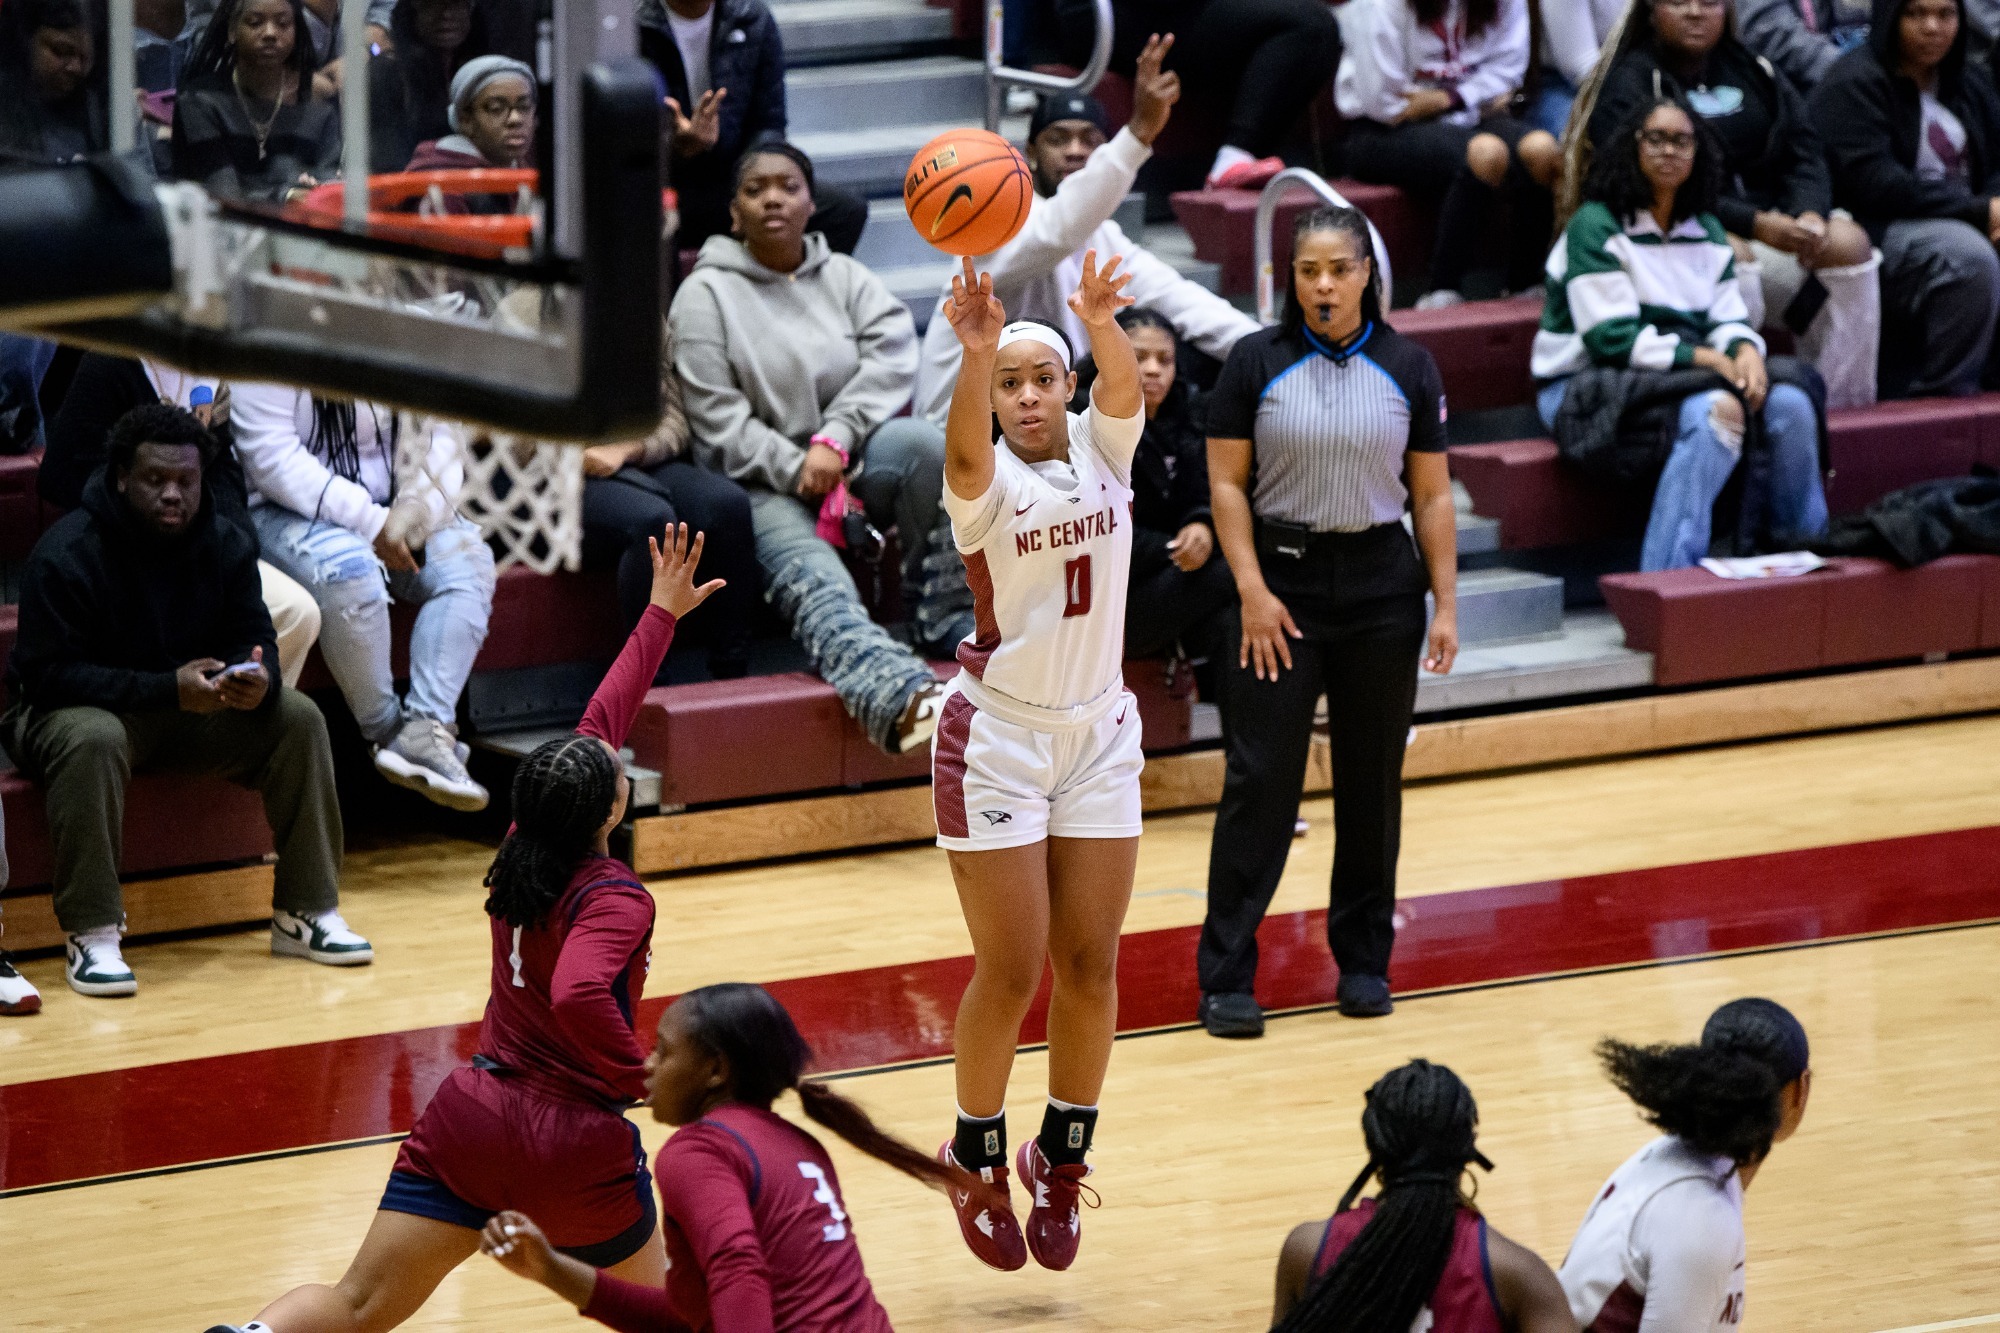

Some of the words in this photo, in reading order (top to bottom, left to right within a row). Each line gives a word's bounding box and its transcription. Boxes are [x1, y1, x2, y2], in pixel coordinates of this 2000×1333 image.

[1015, 529, 1042, 557] NC
[1062, 552, 1094, 620] 0
[508, 924, 526, 988] 1
[797, 1161, 847, 1242] 3
